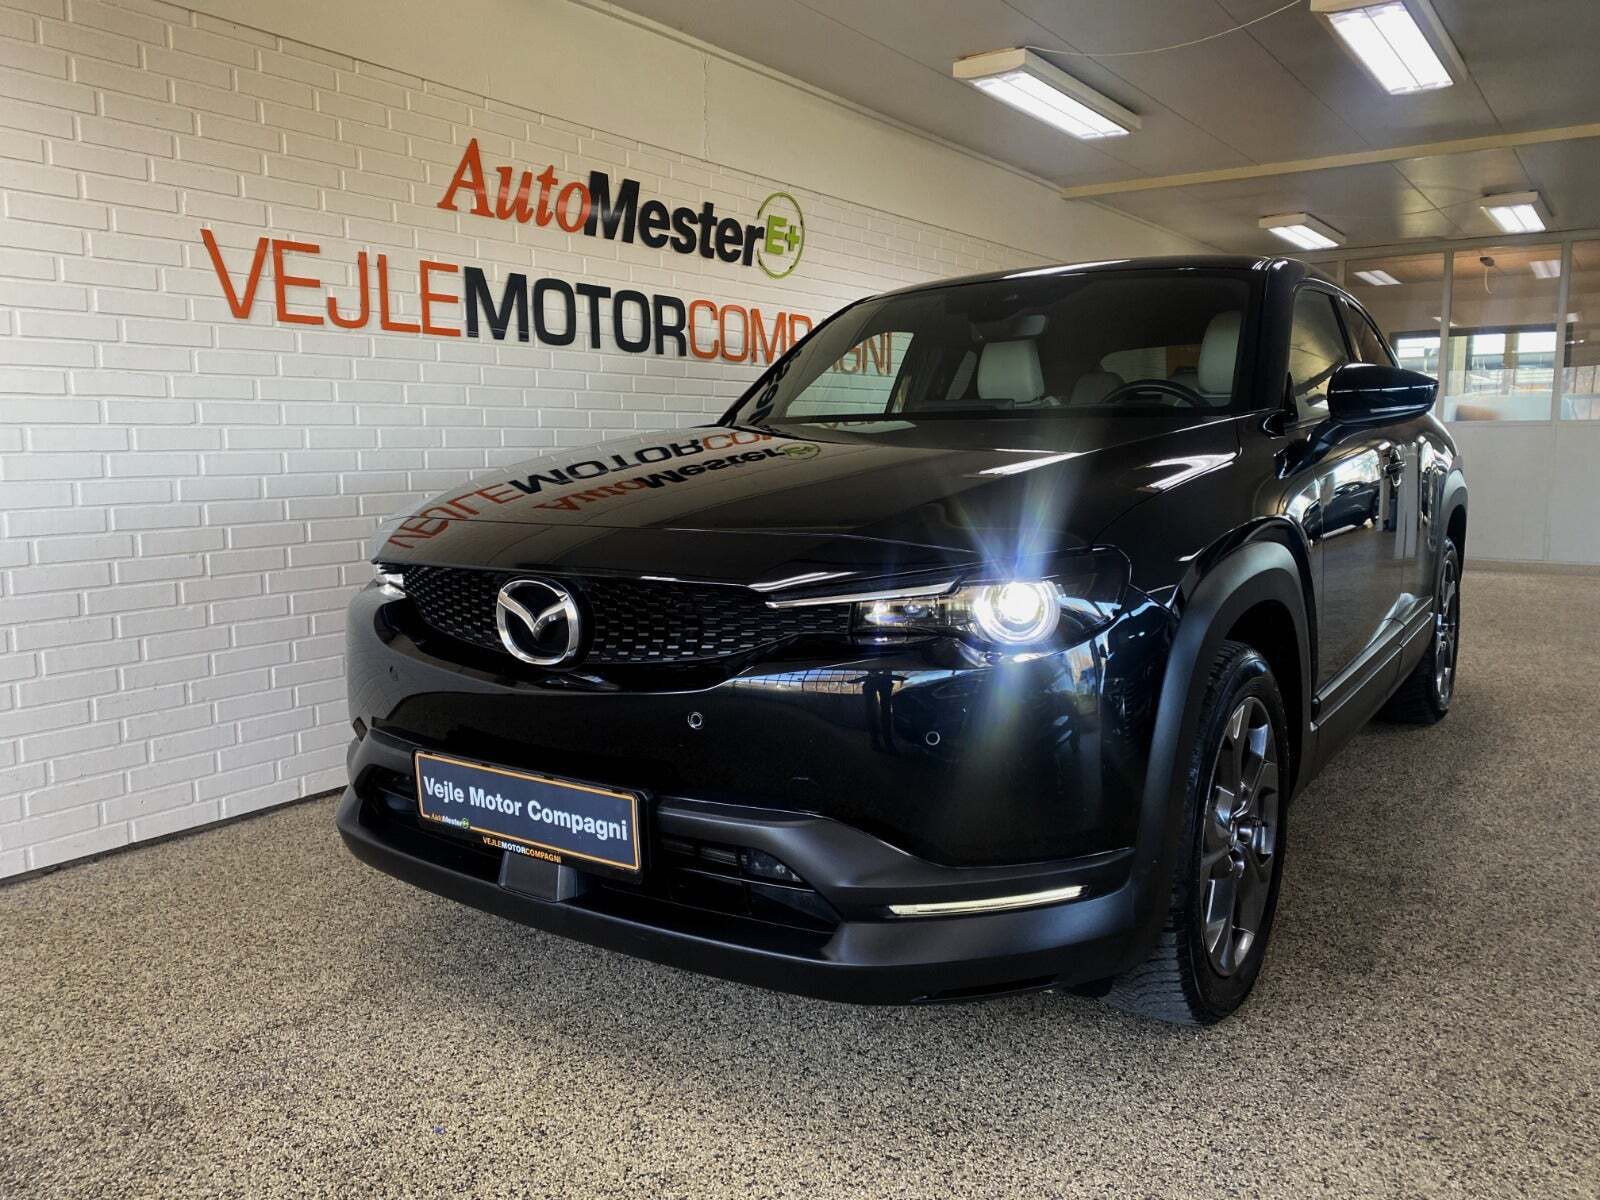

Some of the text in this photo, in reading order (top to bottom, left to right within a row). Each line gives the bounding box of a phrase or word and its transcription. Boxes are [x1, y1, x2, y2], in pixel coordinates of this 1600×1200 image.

[437, 137, 765, 267] AutoMester
[423, 775, 628, 842] Vejle Motor Compagni
